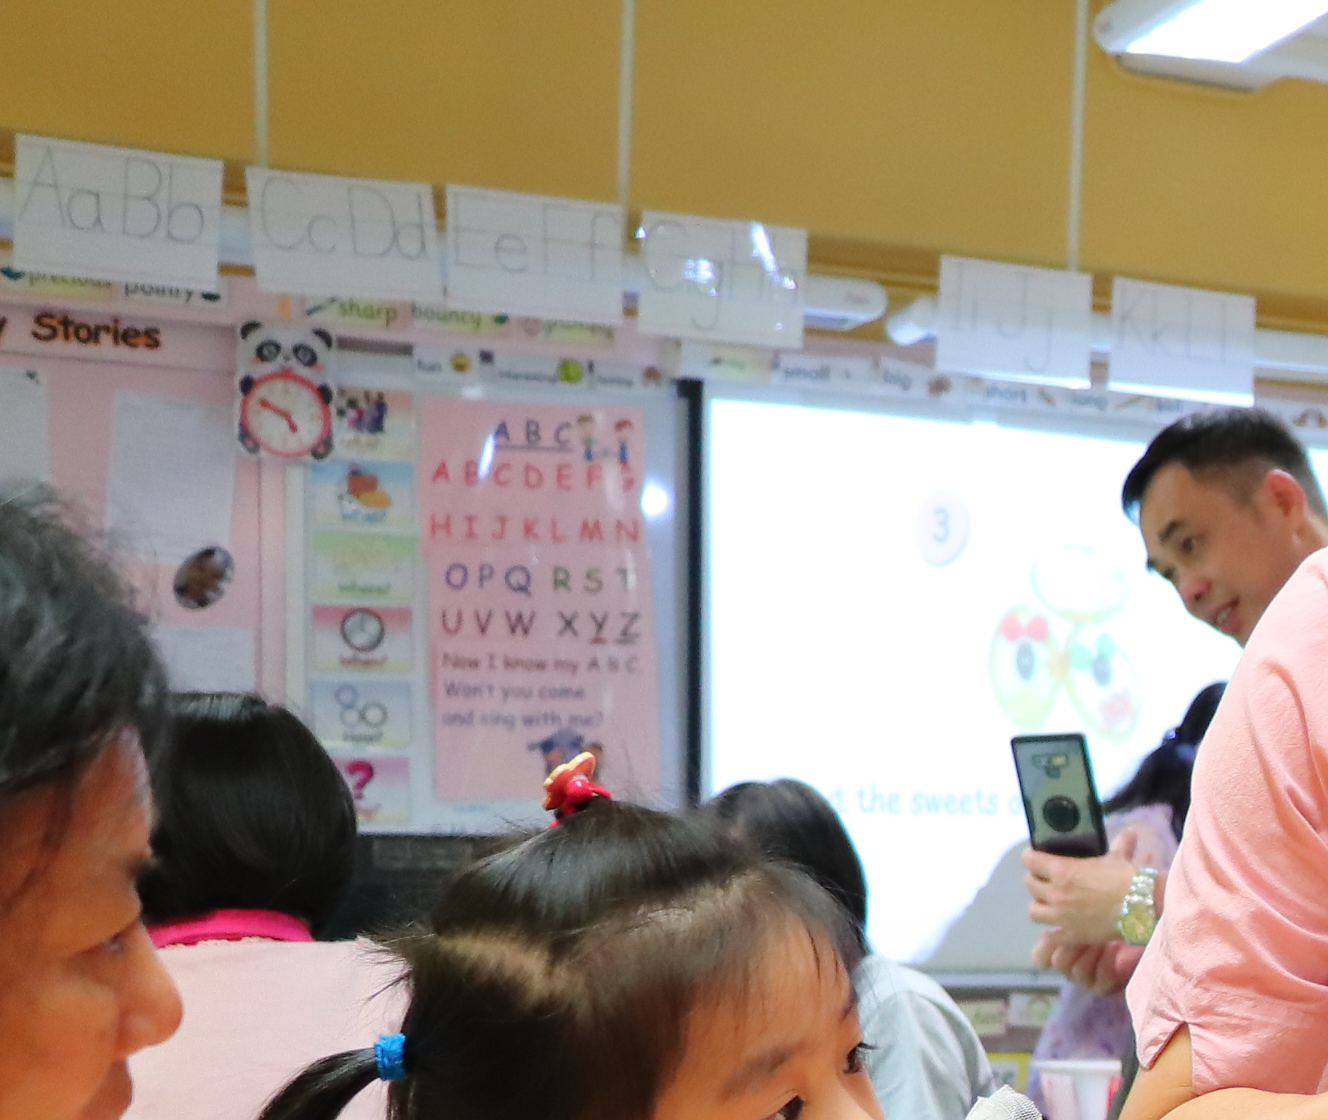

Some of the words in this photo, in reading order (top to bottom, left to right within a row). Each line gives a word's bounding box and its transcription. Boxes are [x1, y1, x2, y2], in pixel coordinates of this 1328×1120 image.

[31, 311, 161, 350] Stories
[931, 507, 951, 543] 3
[442, 654, 479, 671] Now
[503, 654, 547, 672] know
[554, 657, 578, 676] my
[445, 682, 495, 699] Won't
[503, 684, 533, 704] you
[538, 685, 585, 700] come
[442, 710, 474, 727] and
[523, 709, 562, 727] with
[858, 788, 900, 815] the
[911, 785, 999, 815] sweets
